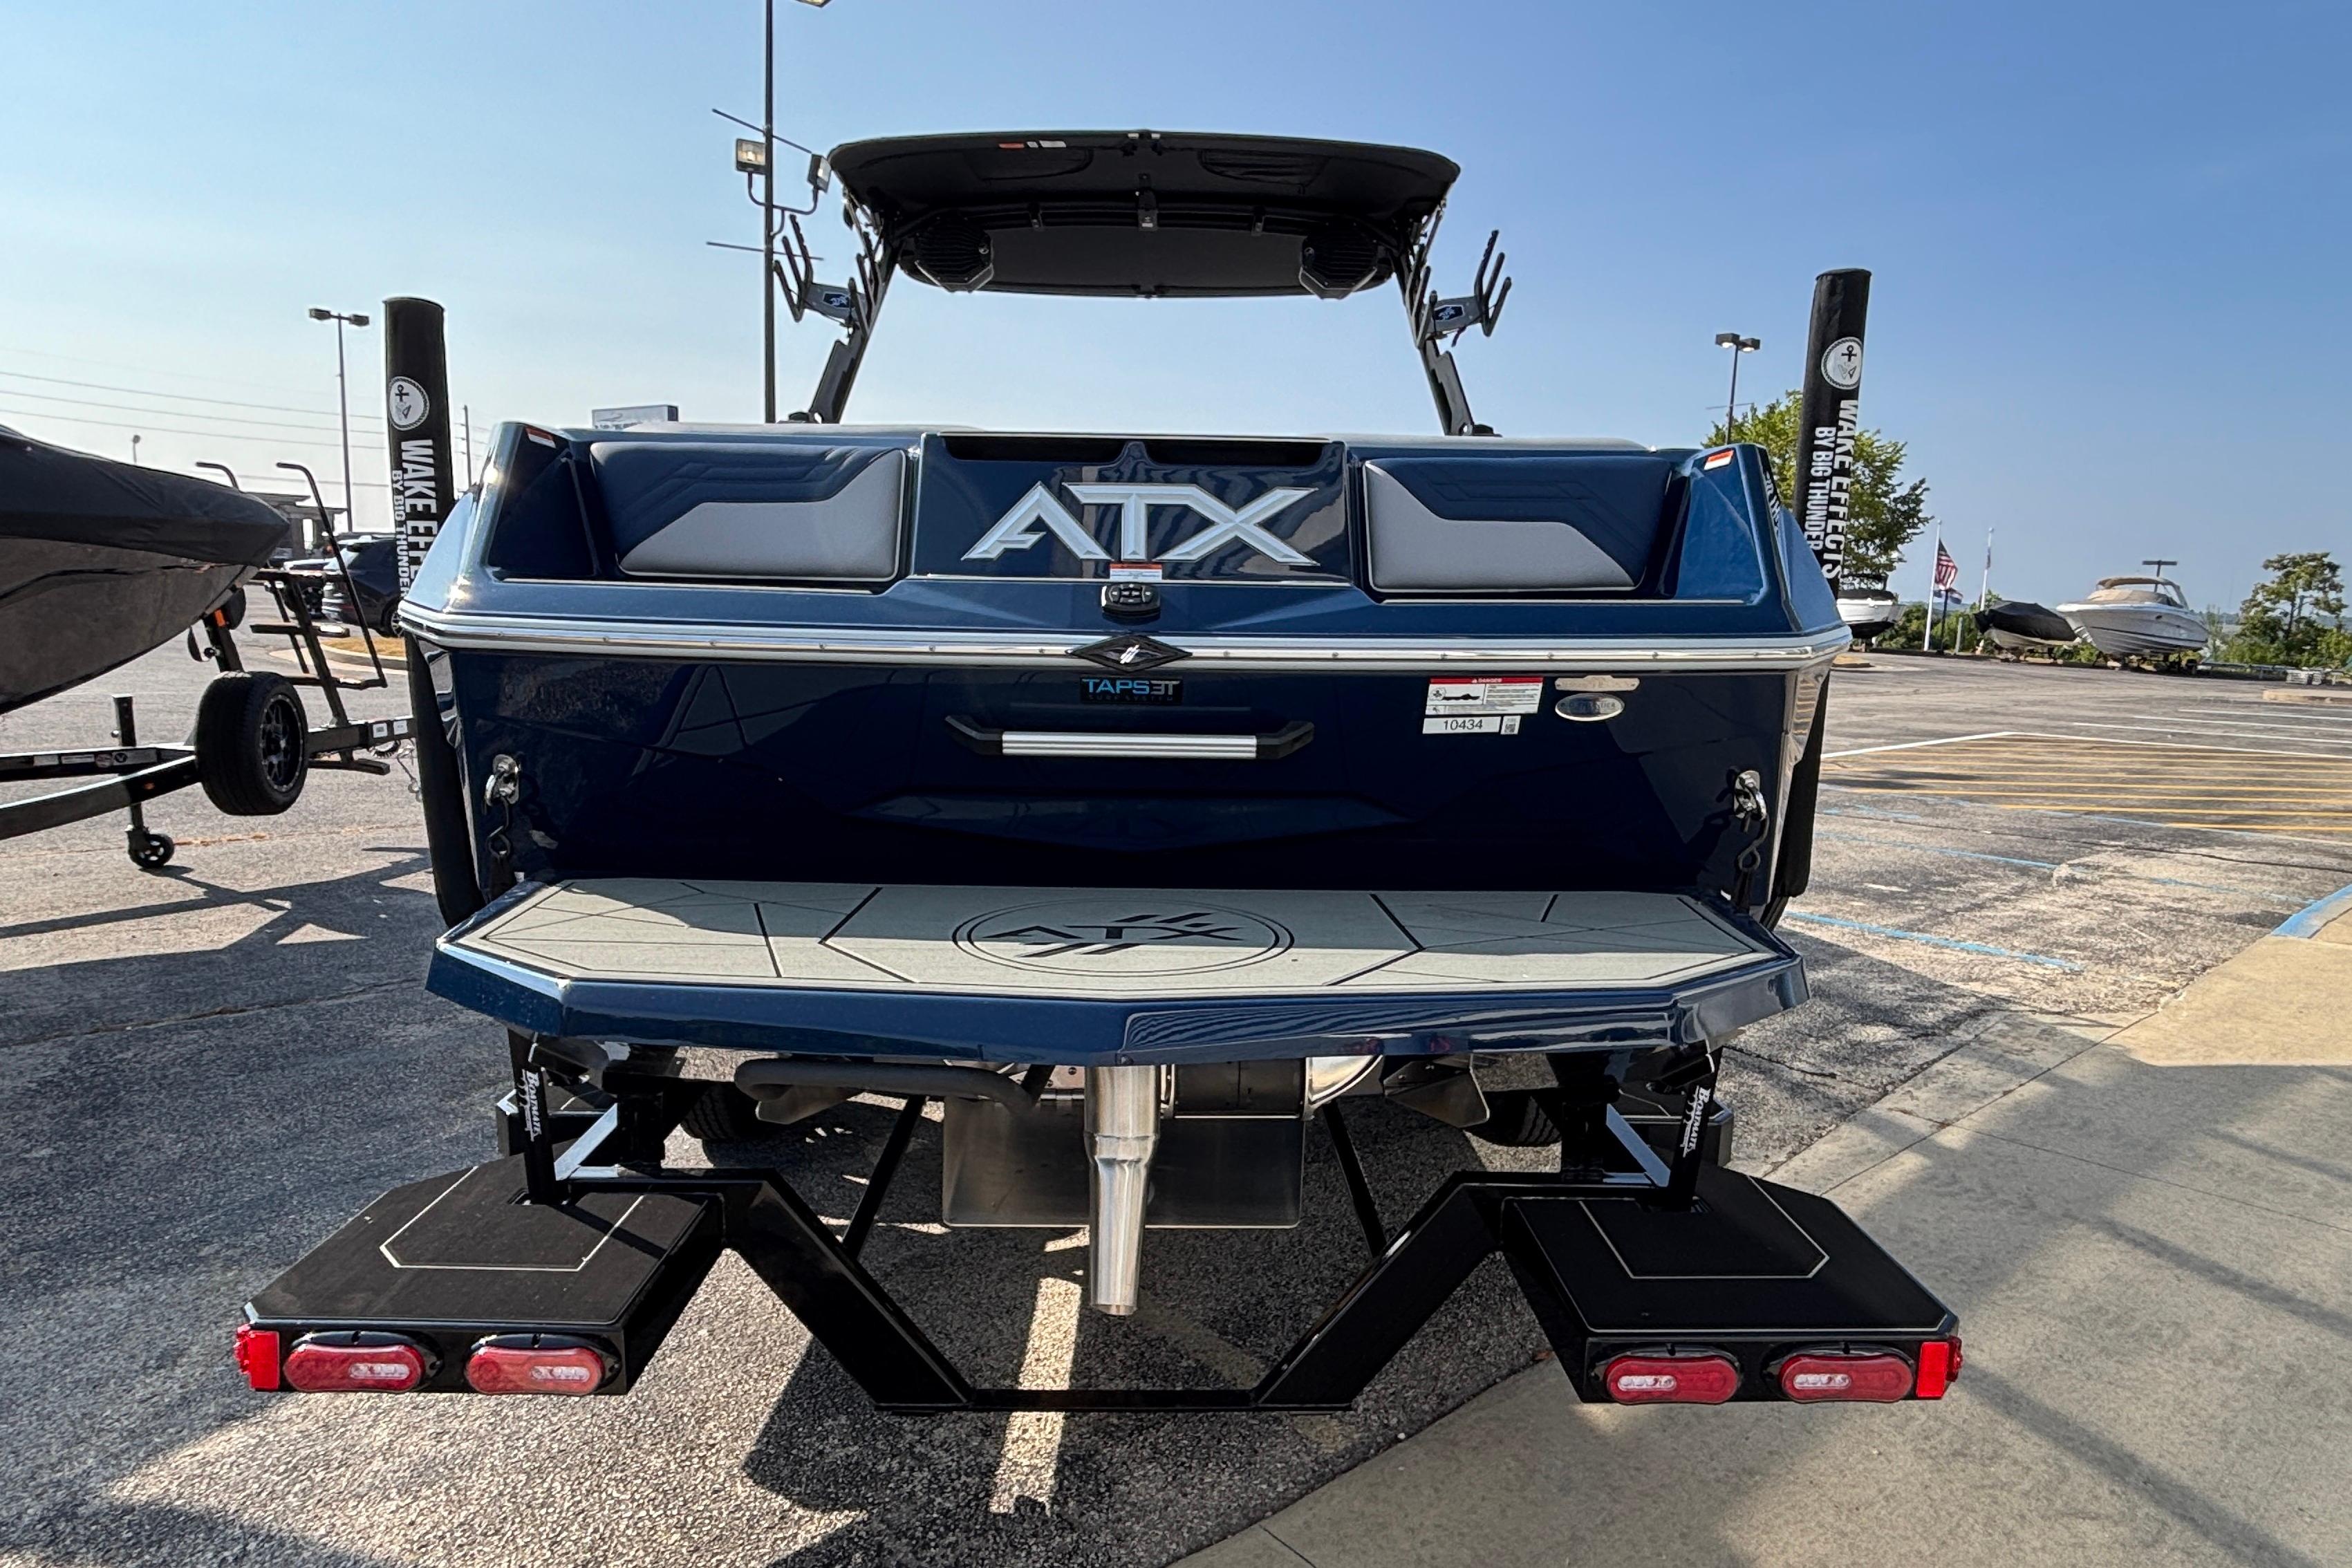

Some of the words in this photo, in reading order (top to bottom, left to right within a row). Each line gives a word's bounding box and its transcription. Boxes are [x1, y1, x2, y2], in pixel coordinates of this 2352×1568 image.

[1814, 427, 1836, 448] BY
[1833, 399, 1858, 471] WAKE
[392, 469, 405, 494] BY
[400, 439, 438, 514] WAKE
[1811, 451, 1833, 477] BIG
[394, 495, 407, 520] BIG
[960, 480, 1320, 566] ATX
[1804, 479, 1830, 550] THUNDER
[1821, 476, 1851, 579] EFFECTS
[395, 524, 410, 597] THUNDER
[1444, 719, 1483, 731] 10434
[982, 925, 1244, 941] ATX
